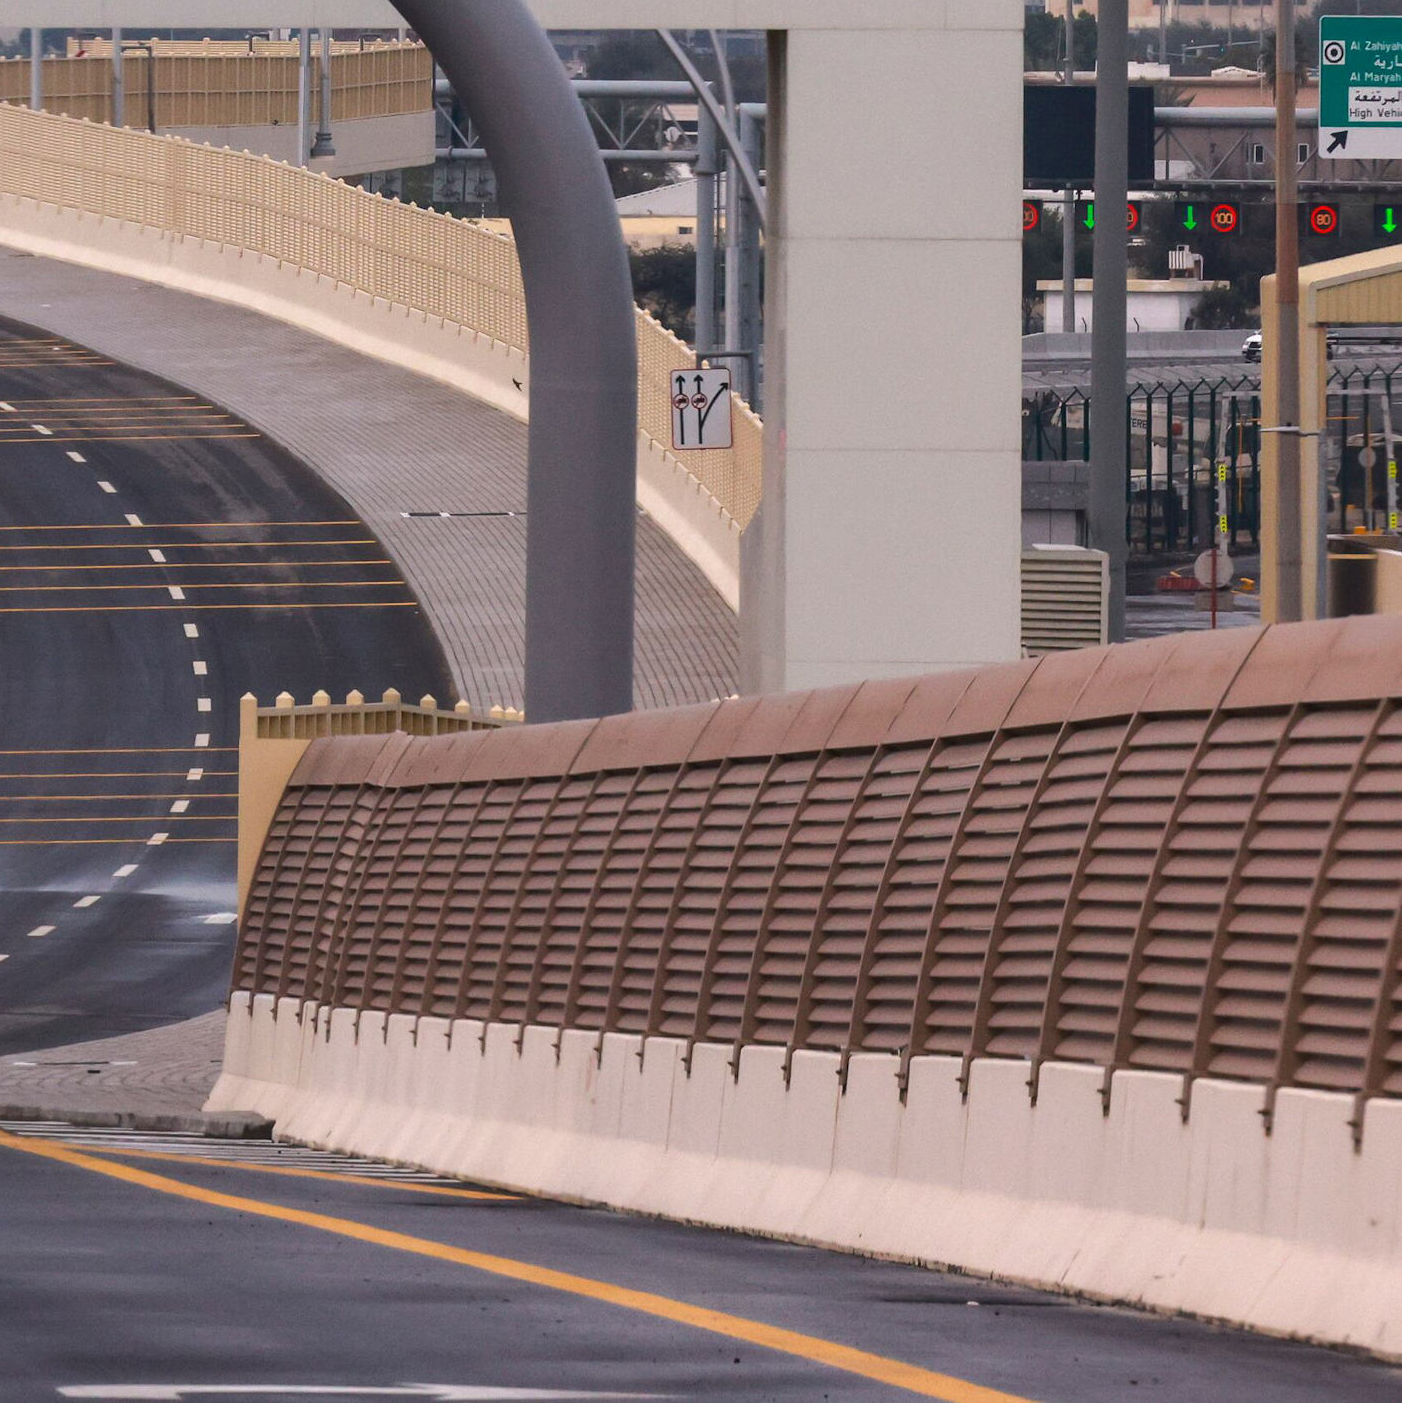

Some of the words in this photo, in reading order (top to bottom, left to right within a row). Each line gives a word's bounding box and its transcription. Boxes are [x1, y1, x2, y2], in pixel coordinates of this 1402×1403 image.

[1349, 108, 1373, 119] High
[1215, 213, 1233, 224] 100
[1316, 213, 1331, 225] 80
